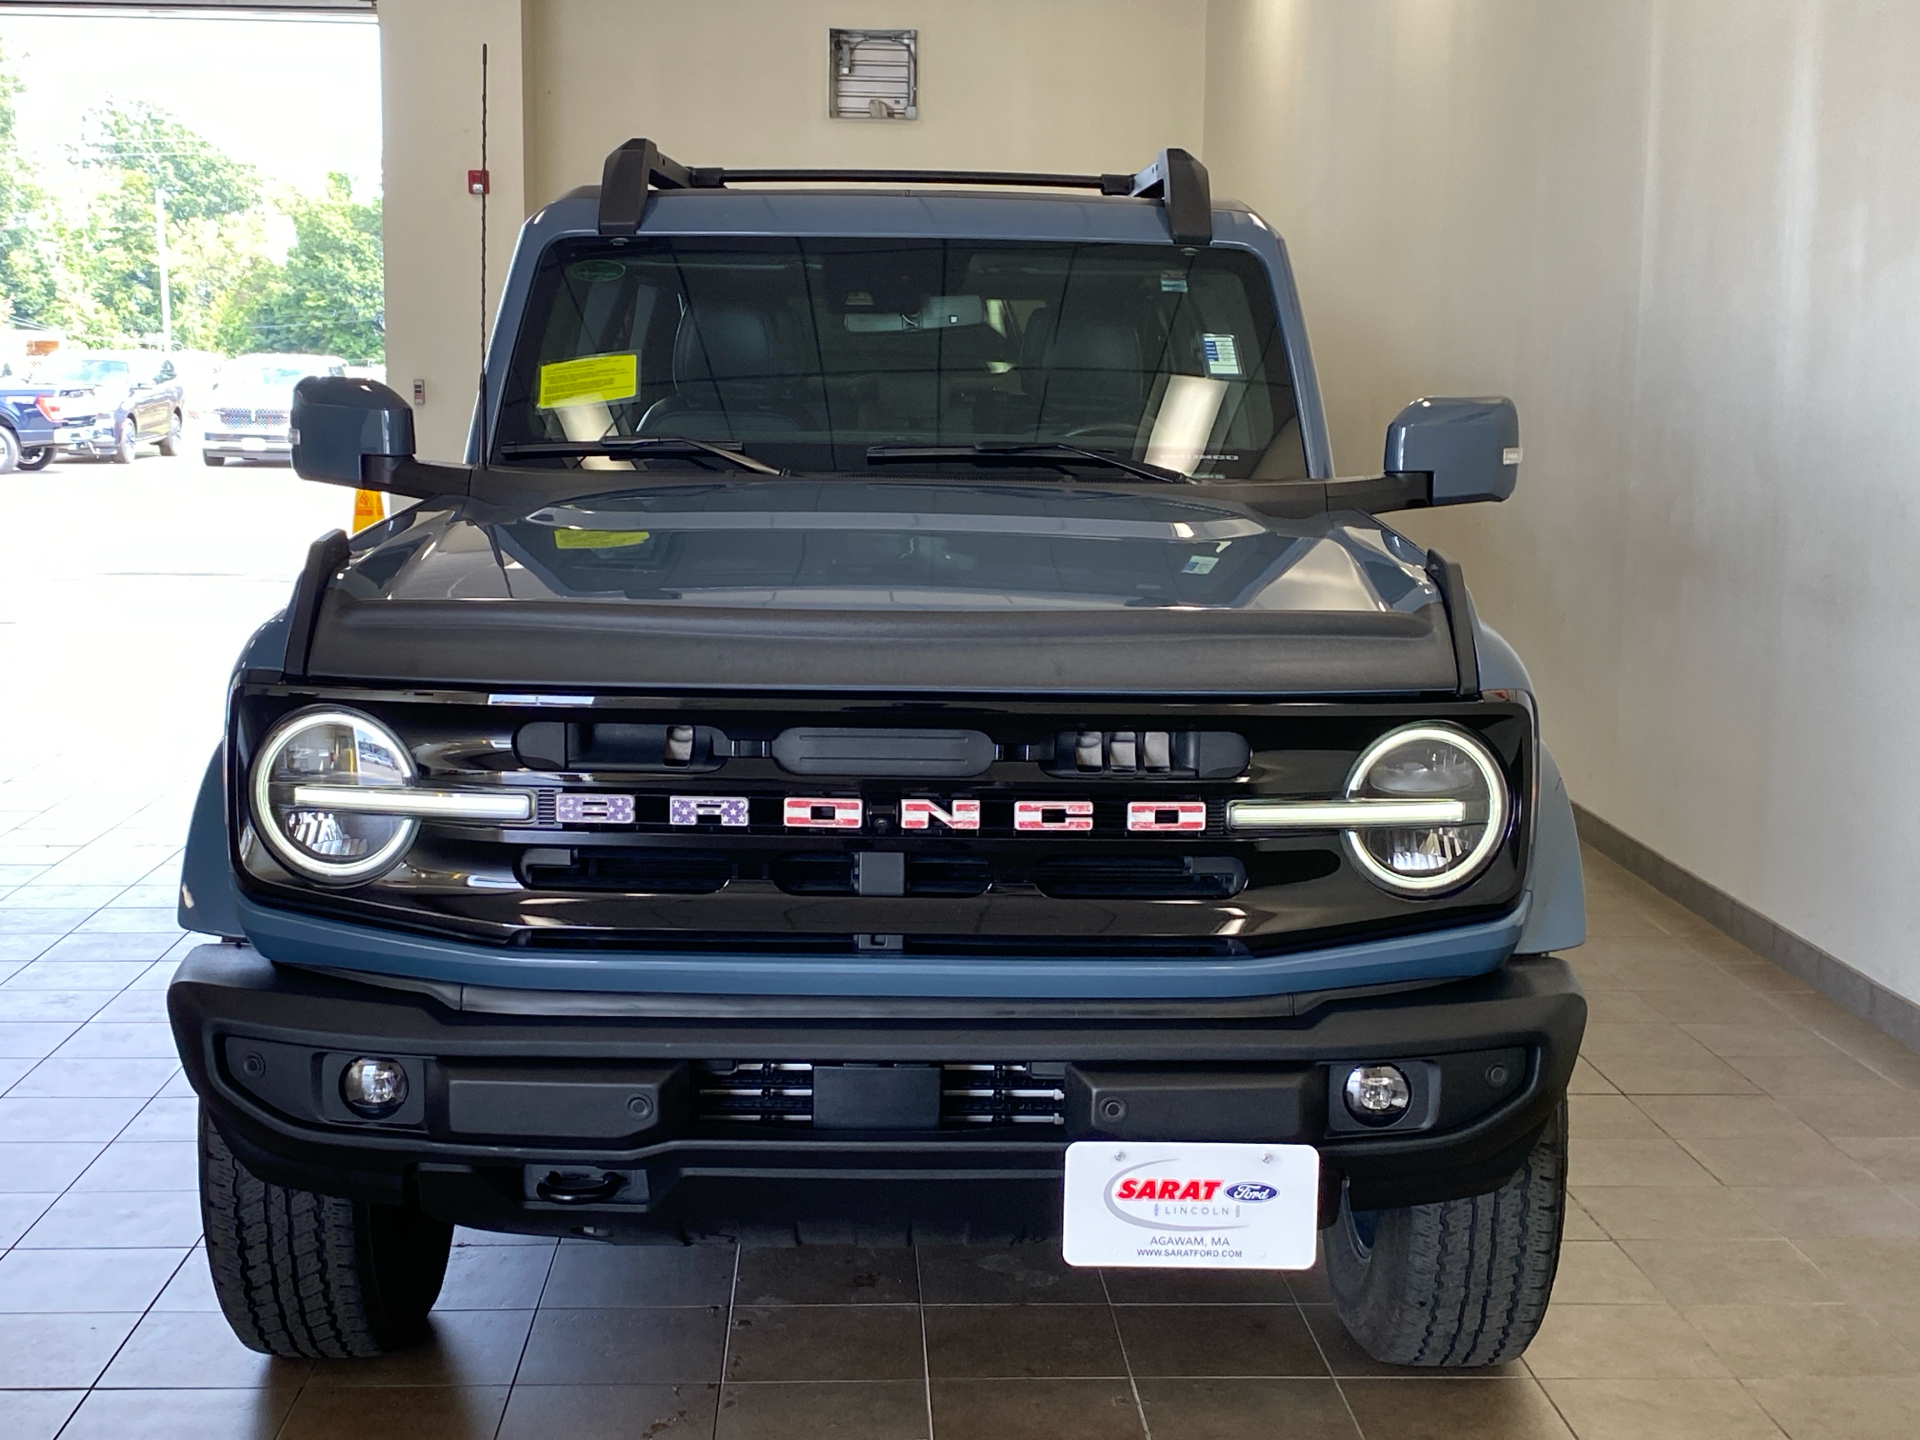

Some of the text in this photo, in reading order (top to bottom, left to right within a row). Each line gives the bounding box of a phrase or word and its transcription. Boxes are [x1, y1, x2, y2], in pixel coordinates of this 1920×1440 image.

[555, 793, 1206, 831] BRONCO
[1116, 1178, 1271, 1202] SARAT Ford
[1165, 1206, 1230, 1216] LINCOLN
[1149, 1236, 1231, 1247] AGAWAM, MA
[1137, 1248, 1243, 1259] WWW.SARATFORD.COM
